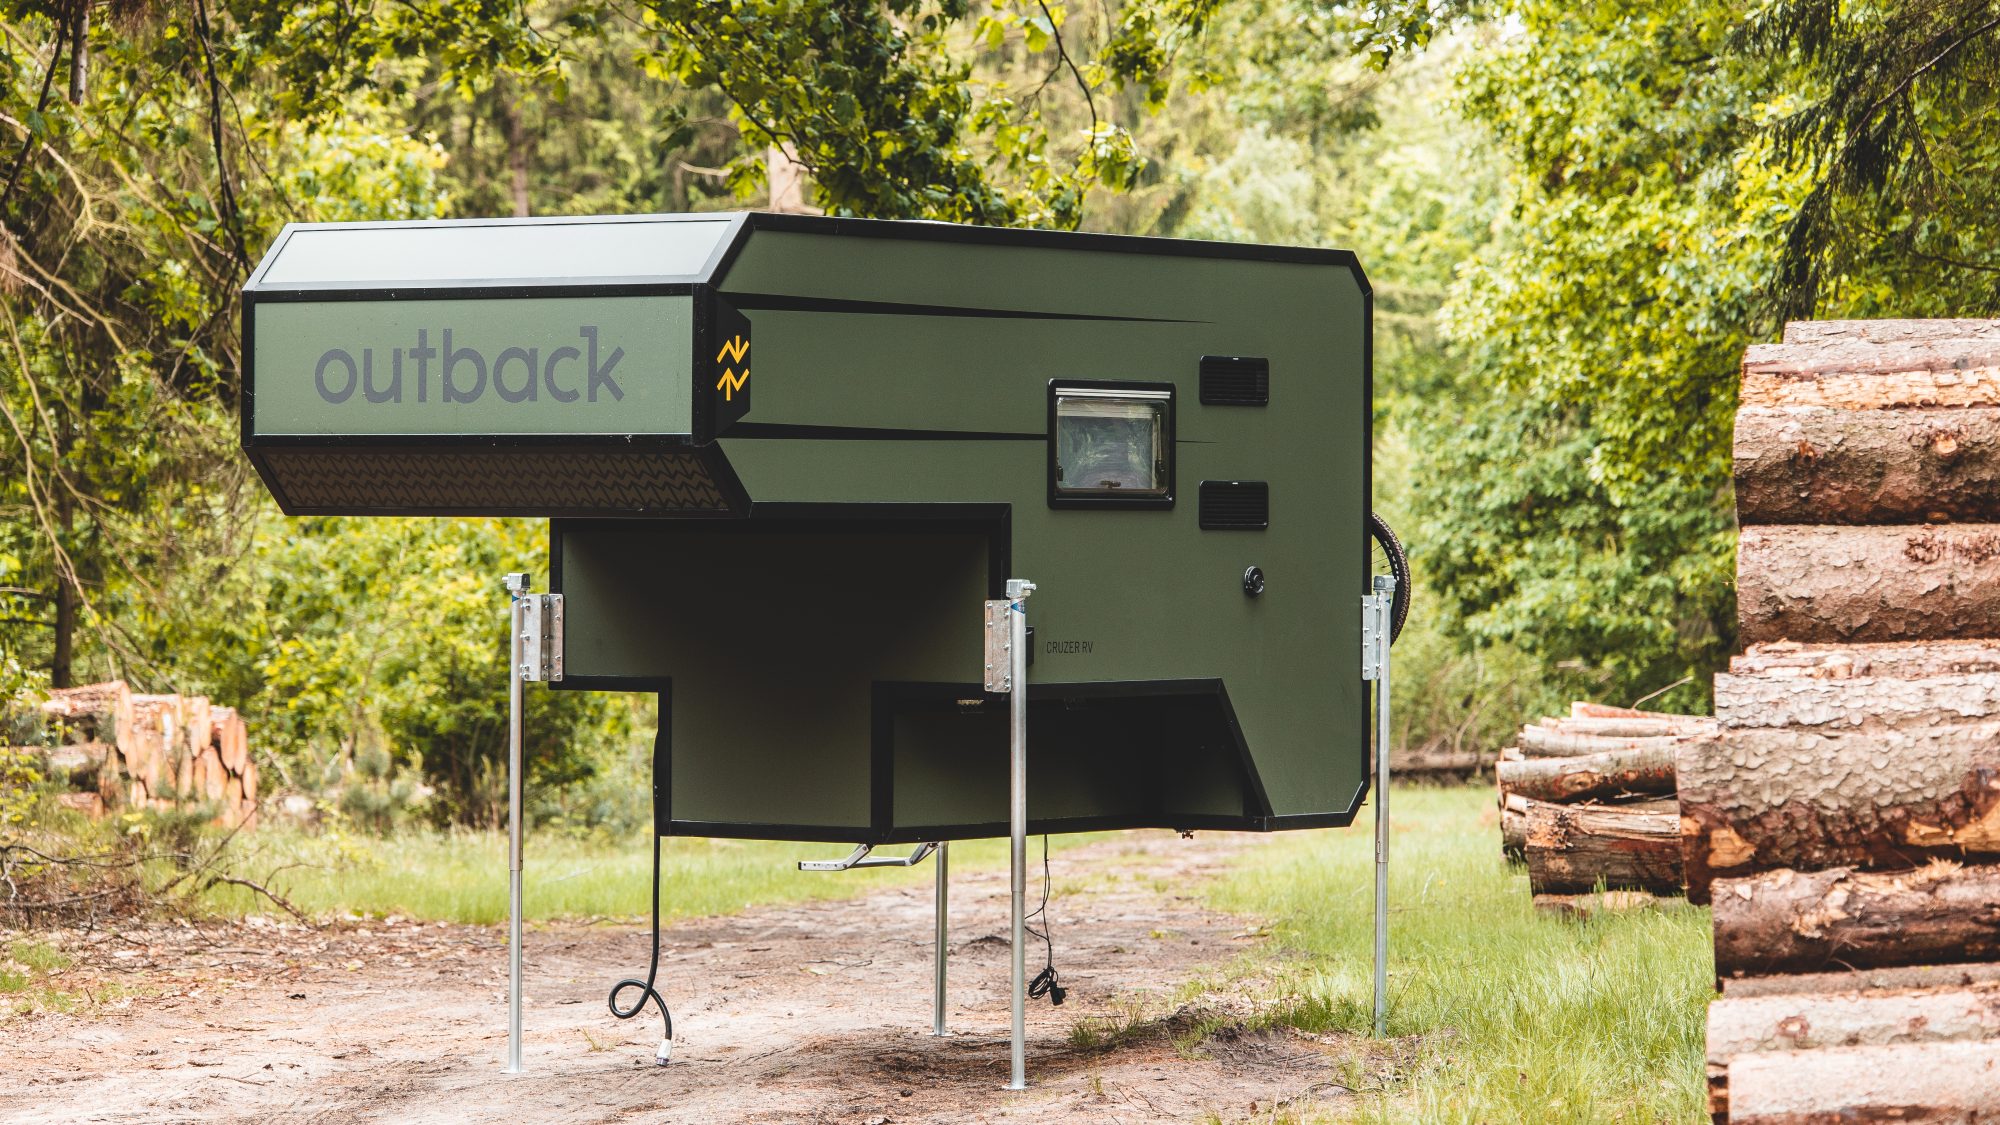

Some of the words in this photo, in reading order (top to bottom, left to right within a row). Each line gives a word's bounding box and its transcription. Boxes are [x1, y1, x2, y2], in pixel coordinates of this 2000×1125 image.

[314, 325, 625, 404] outback
[1046, 641, 1080, 654] CRUZER
[1082, 641, 1094, 654] RV
